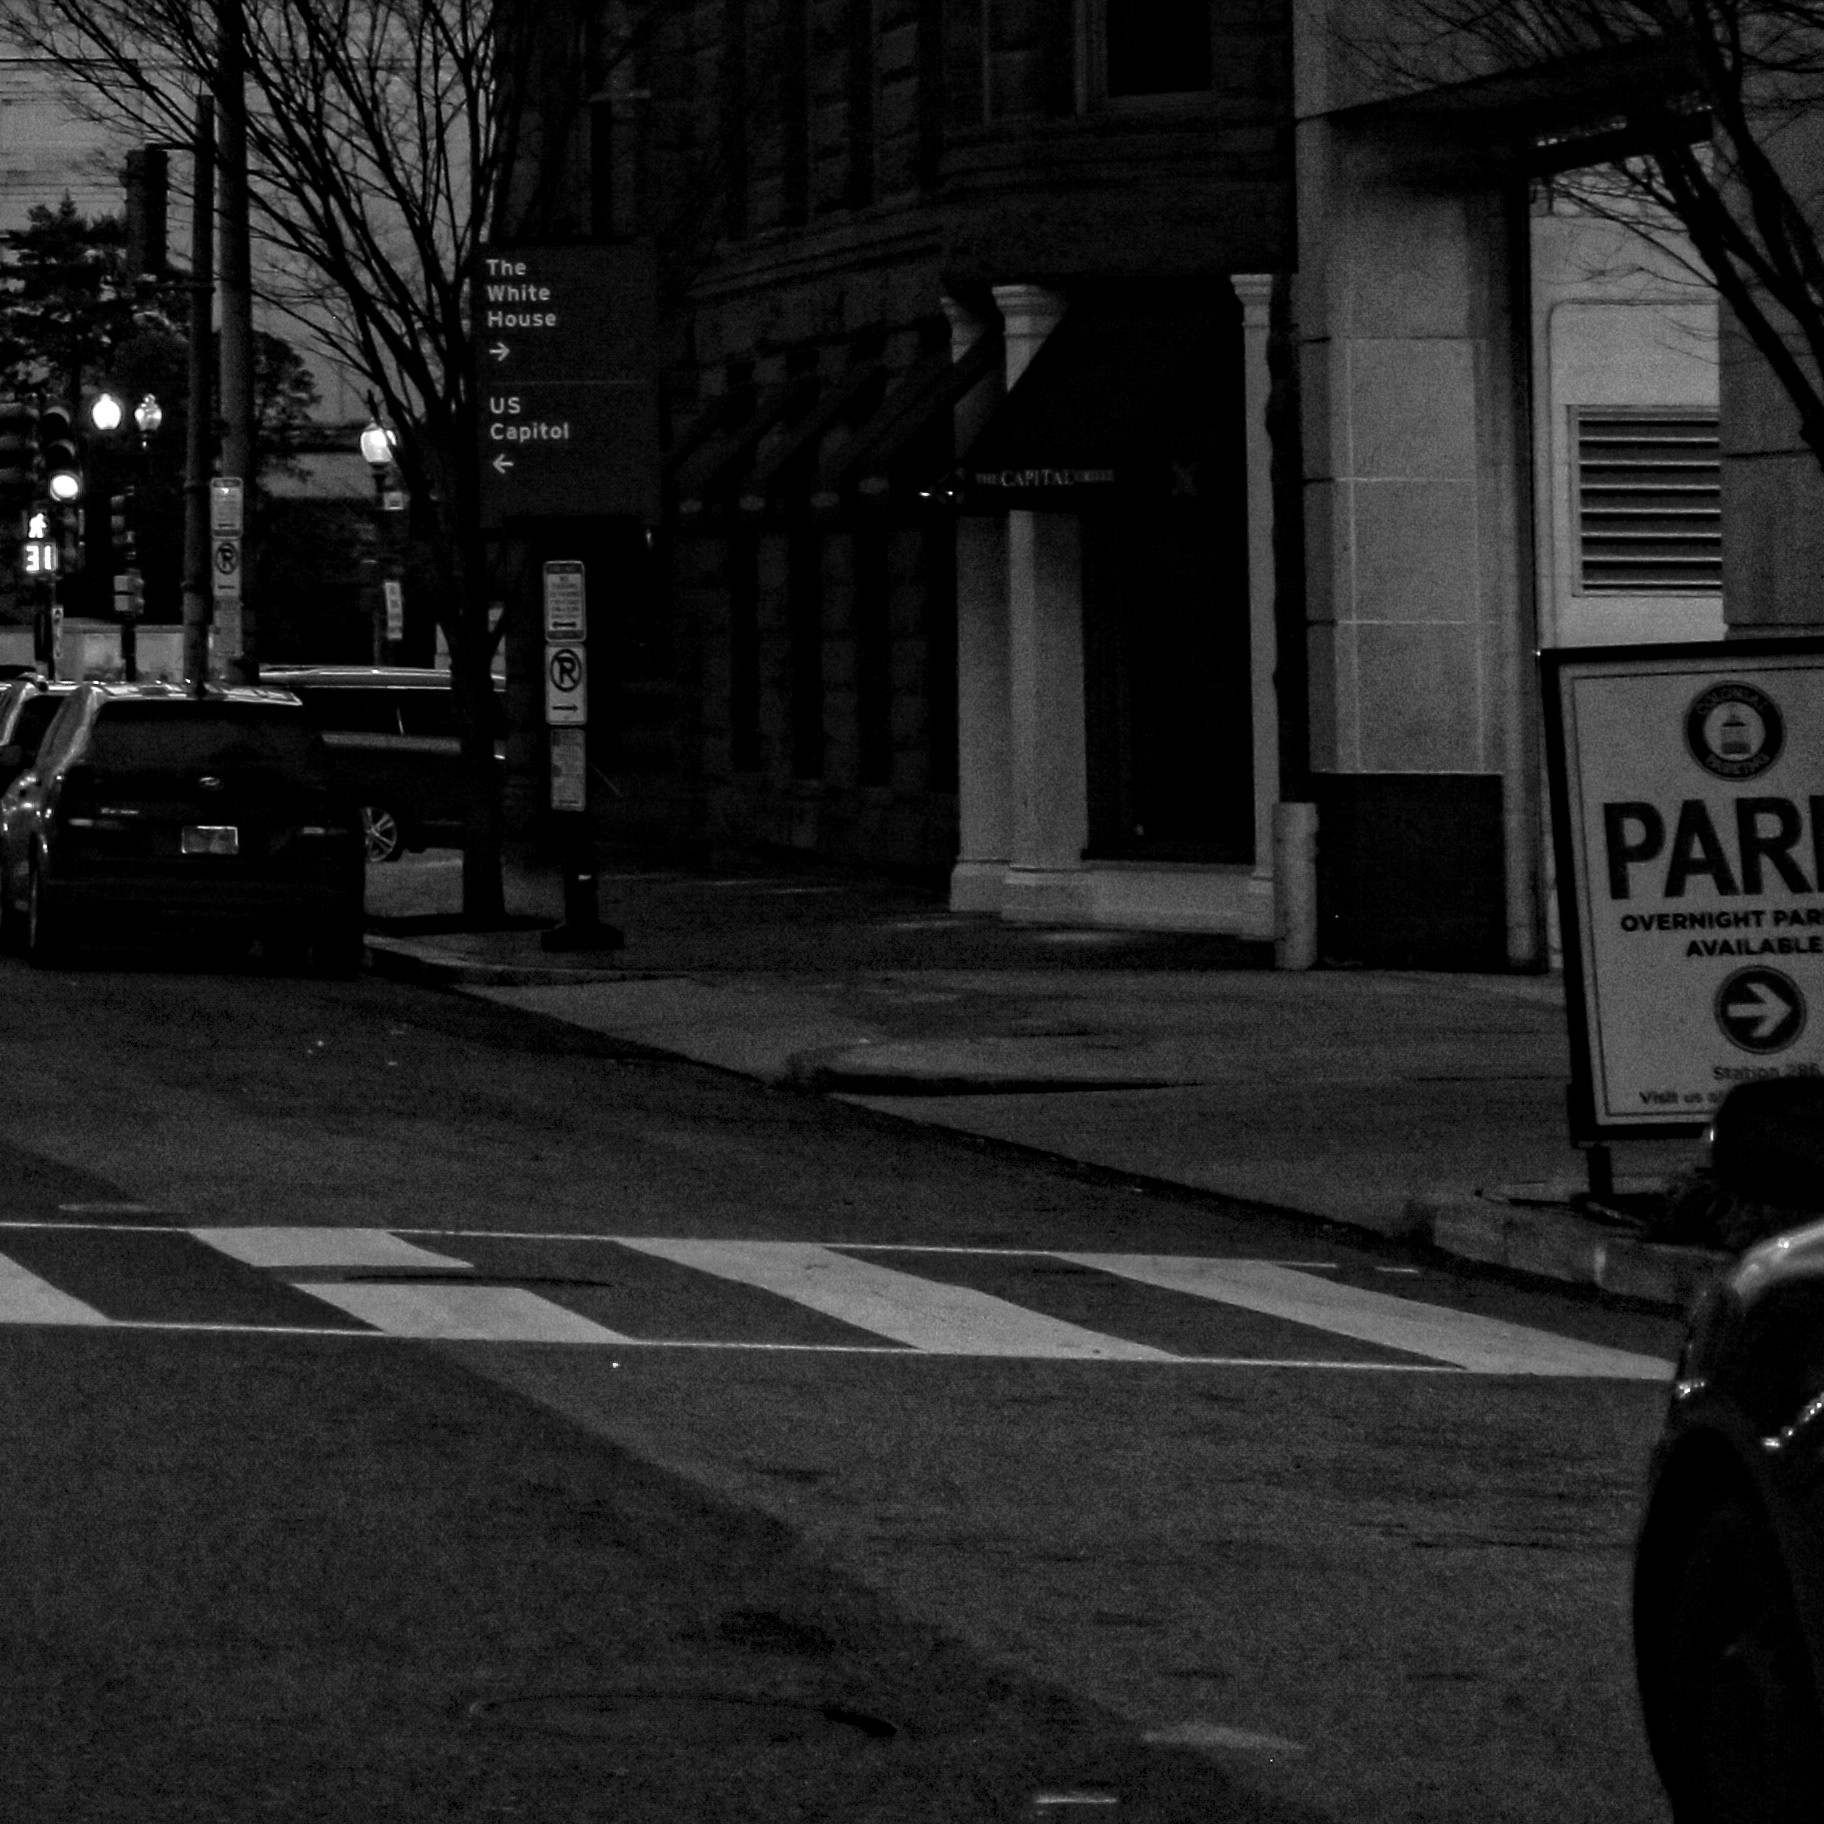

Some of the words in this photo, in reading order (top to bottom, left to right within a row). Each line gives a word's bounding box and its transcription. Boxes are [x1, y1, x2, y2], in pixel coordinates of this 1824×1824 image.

[485, 258, 527, 276] The
[487, 284, 551, 302] White
[487, 310, 557, 328] House
[489, 396, 522, 415] US
[489, 421, 569, 444] Capitol
[1000, 469, 1074, 487] CAPITAL
[1603, 795, 1824, 901] PAR
[1620, 910, 1766, 932] OVERNIGHT
[1773, 908, 1824, 927] PAR
[1686, 936, 1824, 958] AVAILABLE
